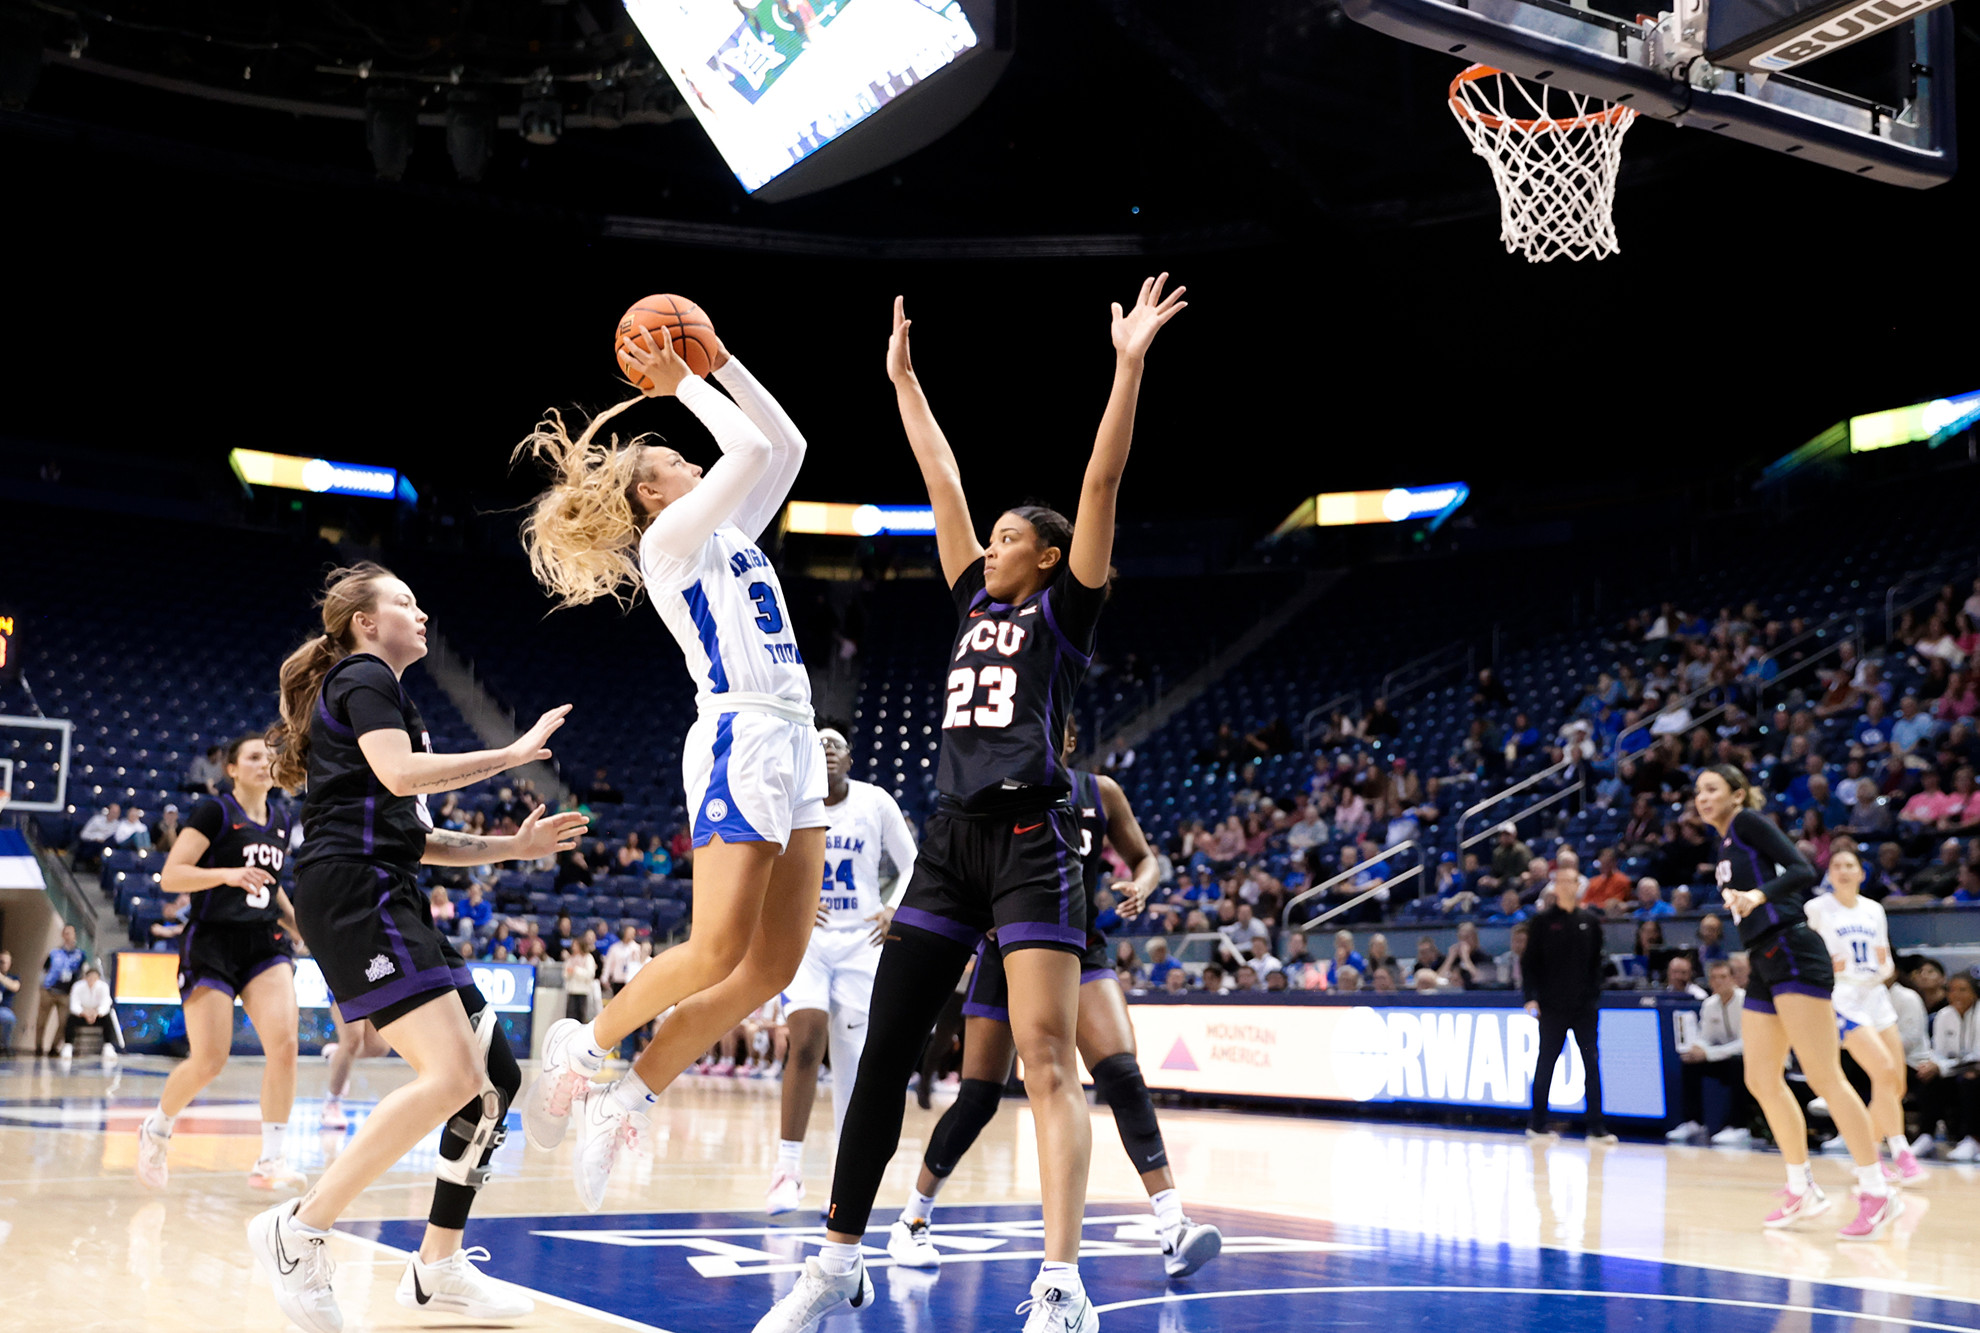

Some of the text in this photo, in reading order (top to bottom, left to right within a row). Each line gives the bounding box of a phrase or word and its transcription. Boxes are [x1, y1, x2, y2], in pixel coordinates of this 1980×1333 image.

[1773, 0, 1934, 61] BUIL
[748, 581, 789, 635] 3
[955, 619, 1026, 657] TCU
[942, 665, 1018, 729] 23
[242, 843, 284, 872] TCU
[825, 835, 865, 854] GHAM
[1852, 940, 1868, 963] 11
[1205, 1023, 1277, 1045] MOUNTAIN
[1210, 1045, 1272, 1068] AMERICA
